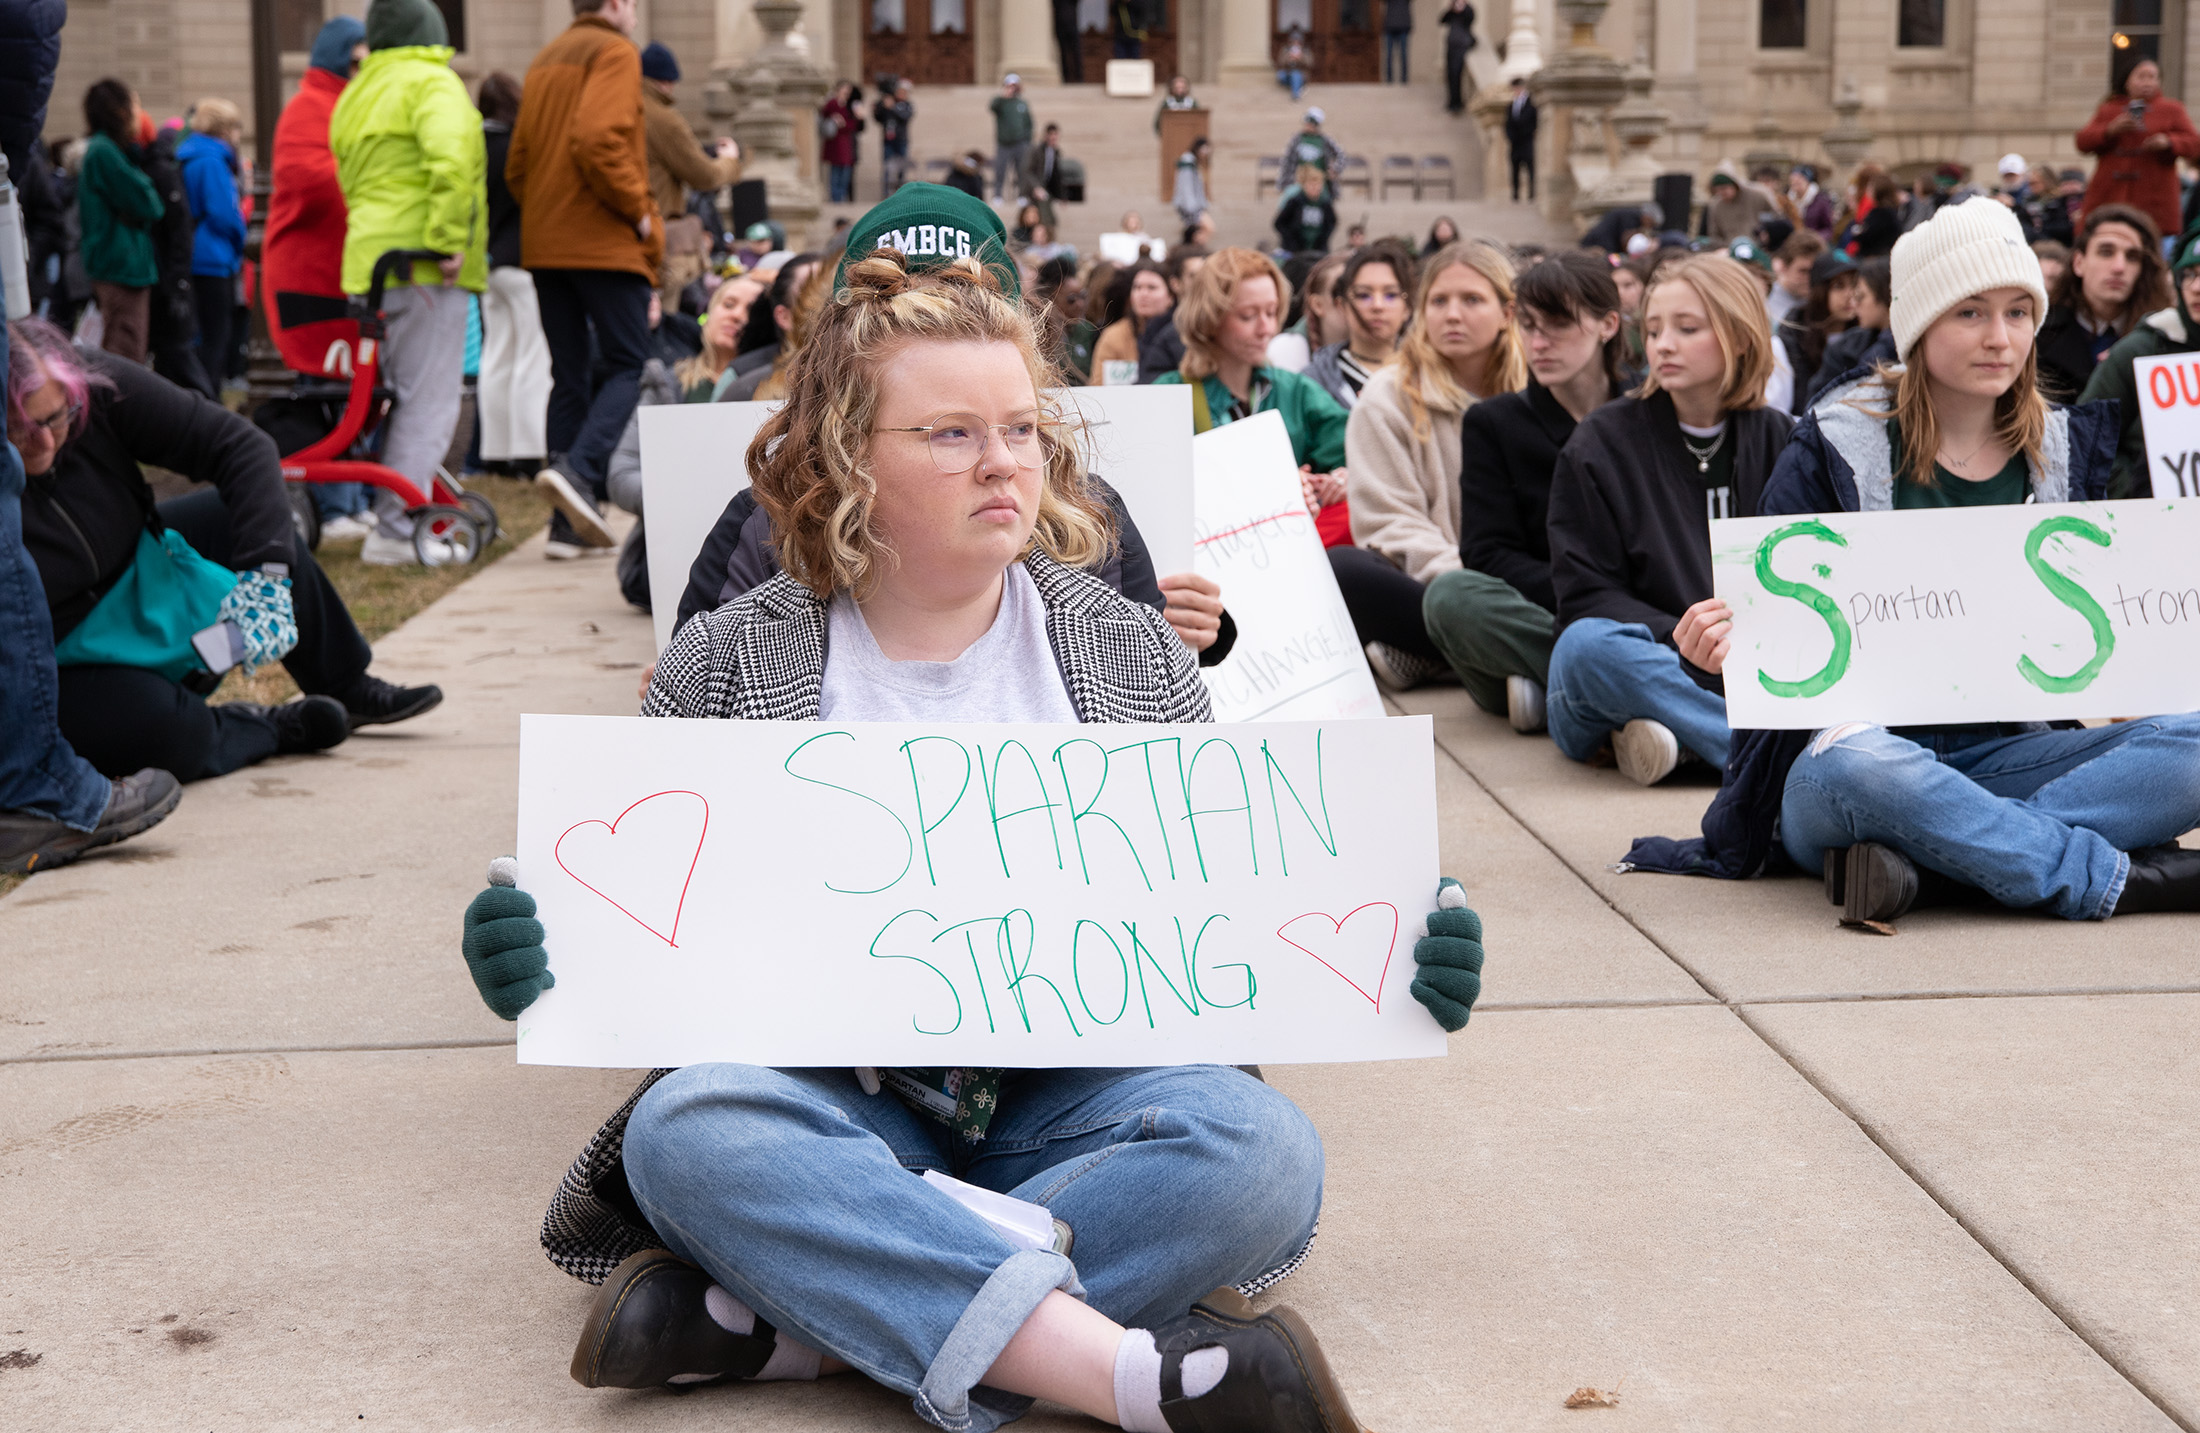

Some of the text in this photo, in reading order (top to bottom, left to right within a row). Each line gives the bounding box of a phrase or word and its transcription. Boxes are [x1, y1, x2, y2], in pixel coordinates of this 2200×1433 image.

[1755, 517, 1966, 699] Spartan
[785, 728, 1337, 894] SPARTAN
[869, 908, 1257, 1037] STRONG
